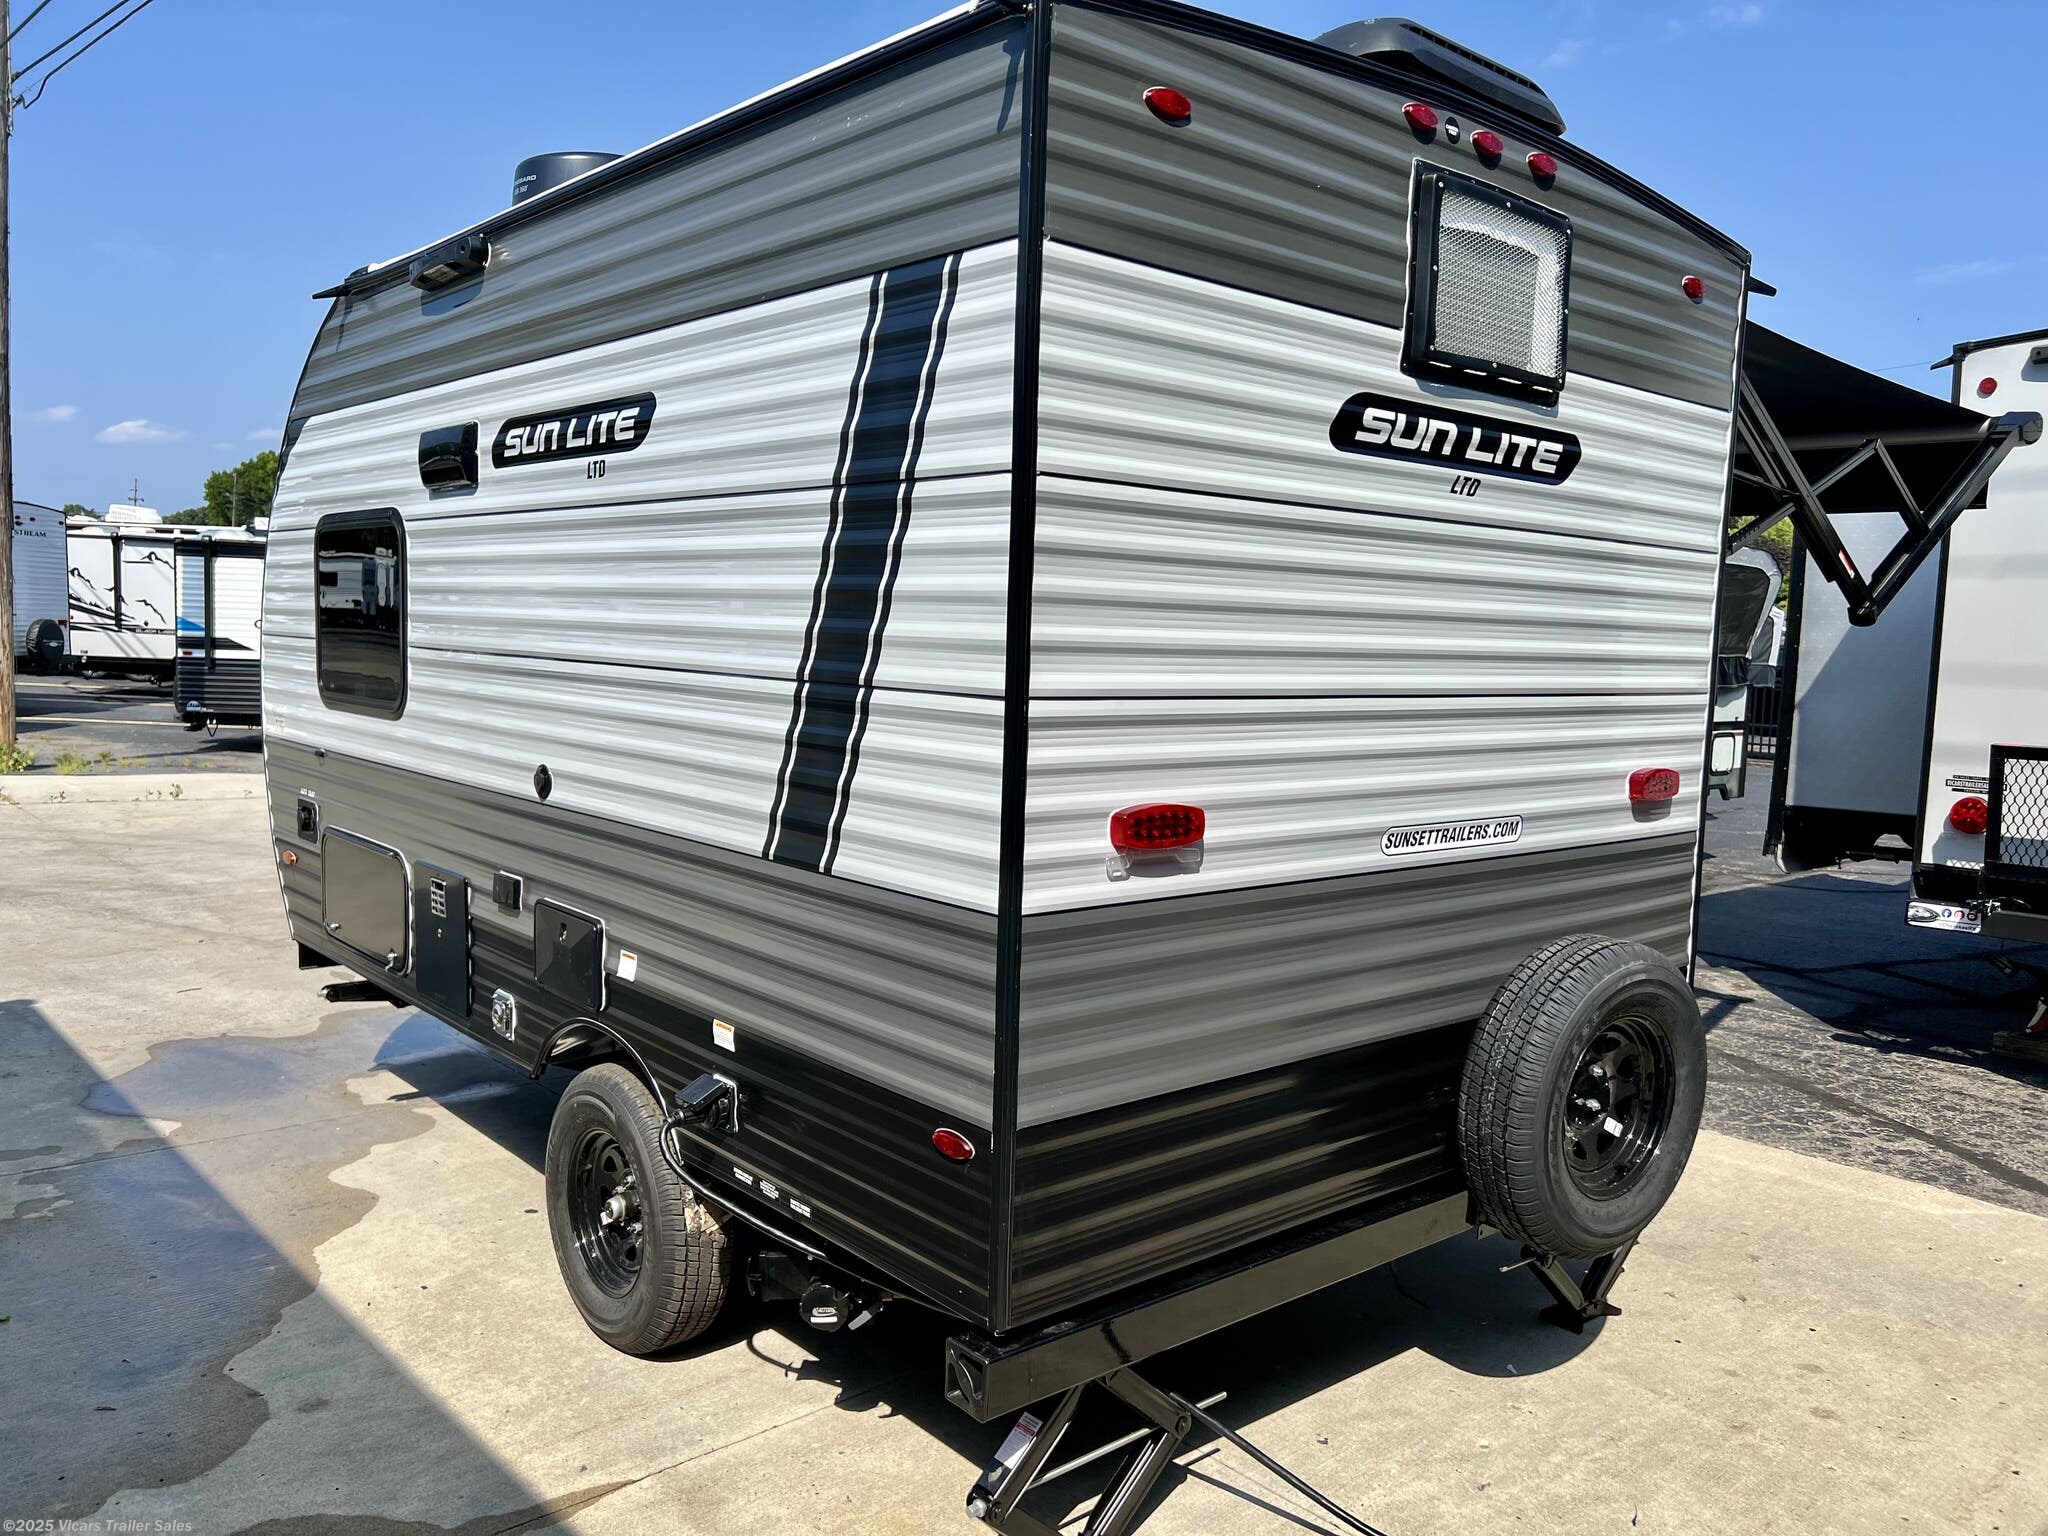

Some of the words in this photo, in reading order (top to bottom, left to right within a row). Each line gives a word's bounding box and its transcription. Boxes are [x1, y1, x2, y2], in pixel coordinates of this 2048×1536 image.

[503, 421, 561, 458] SUN
[566, 406, 641, 449] LITE
[1354, 407, 1458, 455] SUN
[1464, 427, 1564, 474] LITE
[586, 459, 606, 480] LTD
[1449, 474, 1482, 497] LTD
[1384, 820, 1521, 850] SUNSETTRAILERS.COM
